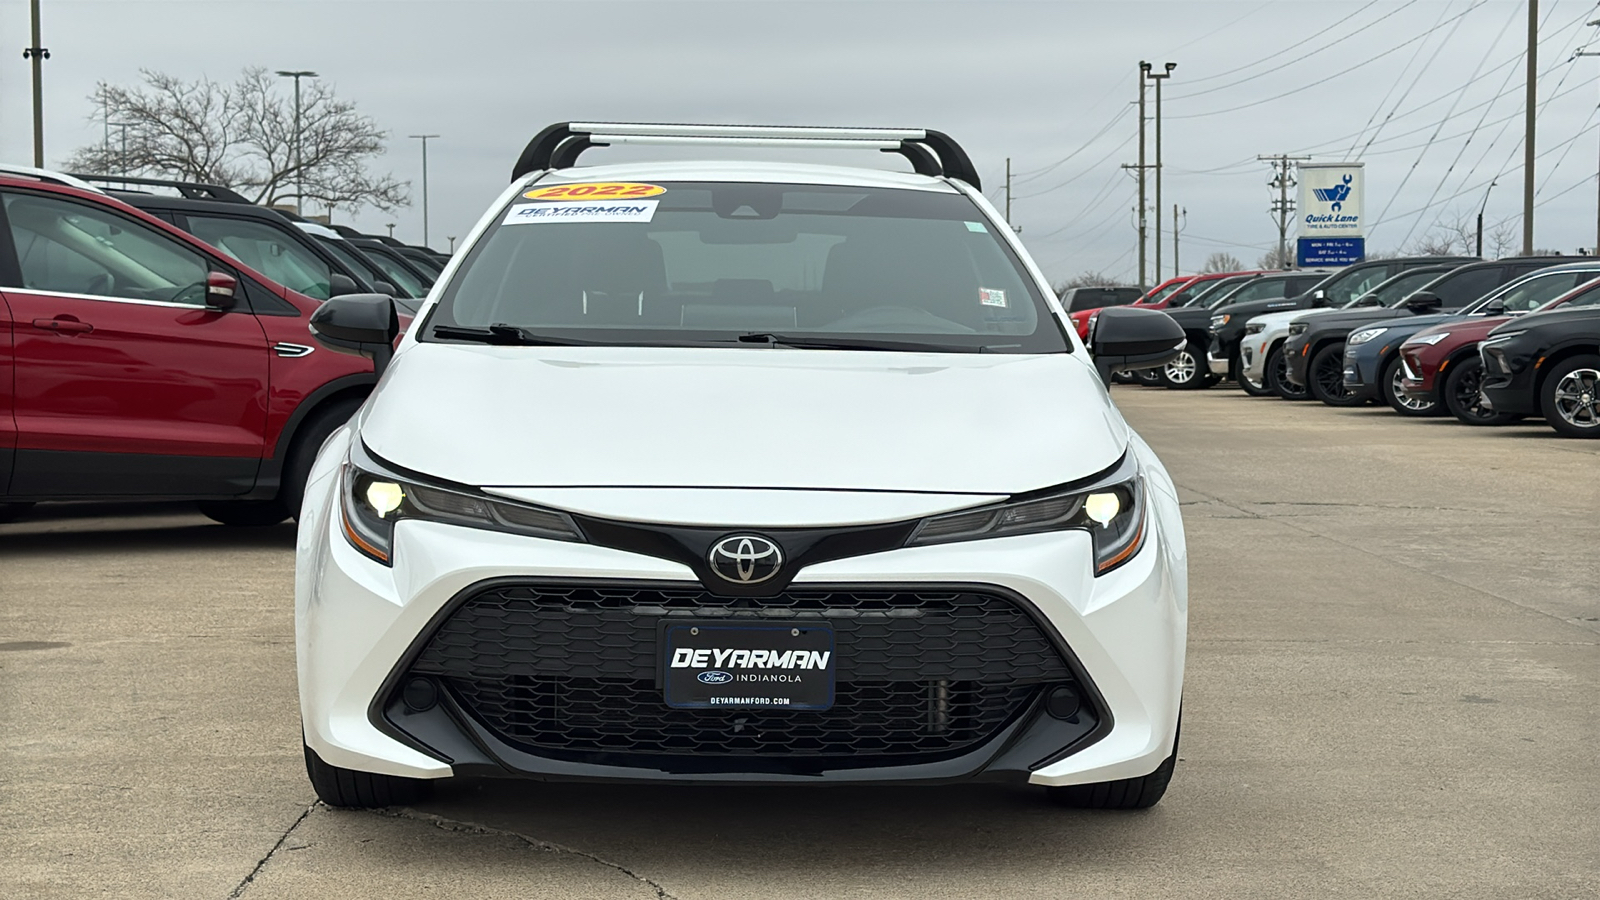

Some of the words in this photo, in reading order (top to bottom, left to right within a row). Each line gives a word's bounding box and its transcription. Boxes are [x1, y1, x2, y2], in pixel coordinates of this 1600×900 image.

[536, 185, 655, 198] 2022
[517, 206, 648, 215] DEYARMAN
[1305, 214, 1334, 223] Quick
[1334, 214, 1359, 222] Lane
[670, 647, 831, 670] DEYARMAN
[702, 671, 728, 683] Ford
[736, 674, 802, 683] INDIANOLA
[710, 697, 790, 705] DEYARMANFORD.COM
